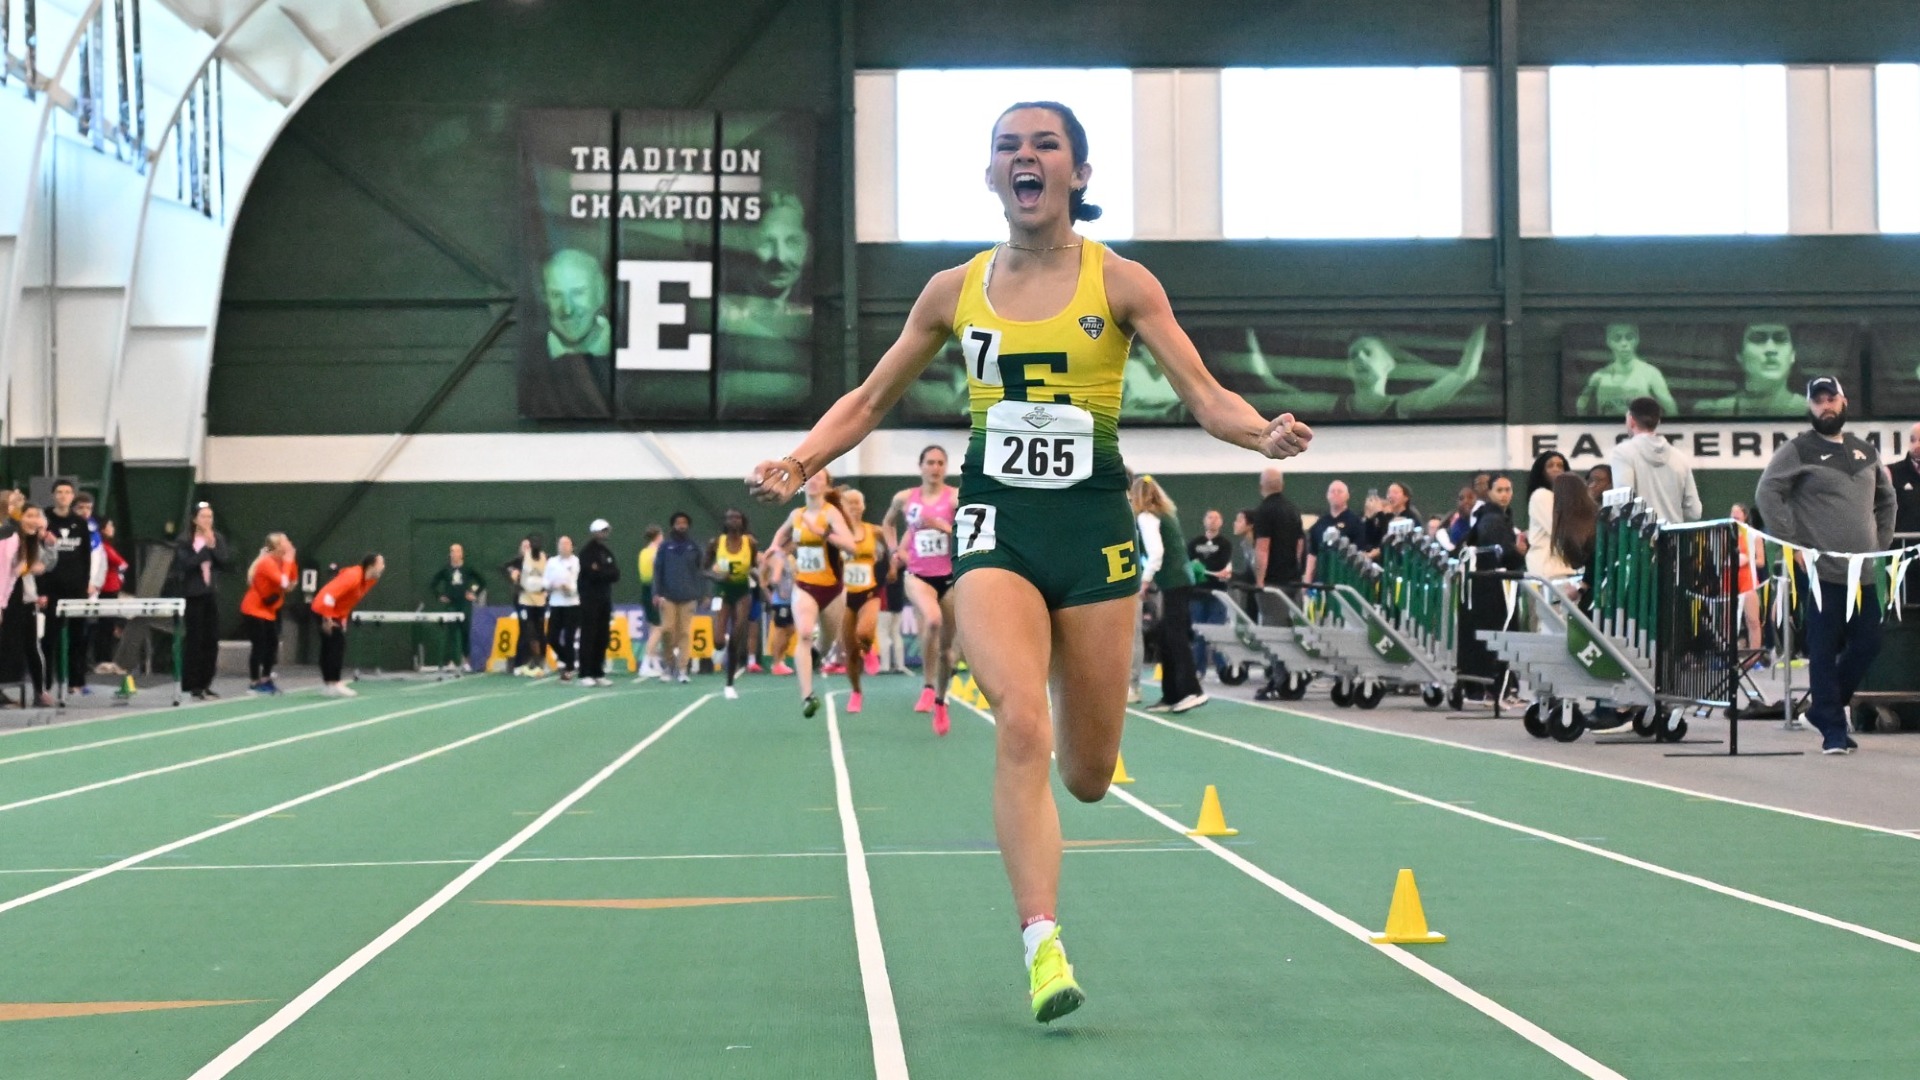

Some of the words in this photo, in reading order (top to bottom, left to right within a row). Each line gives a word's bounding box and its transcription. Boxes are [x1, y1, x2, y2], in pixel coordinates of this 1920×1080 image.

[571, 147, 761, 173] TRADITION
[570, 193, 761, 221] CHAMPIONS
[615, 260, 713, 371] E
[970, 331, 992, 380] 7
[998, 352, 1071, 405] E
[1002, 436, 1075, 477] 265
[1532, 431, 1801, 459] EAER
[964, 508, 987, 550] 7
[1101, 540, 1136, 583] E
[498, 629, 511, 653] 8
[608, 630, 621, 652] 6
[692, 629, 706, 652] 5
[1577, 640, 1603, 667] E
